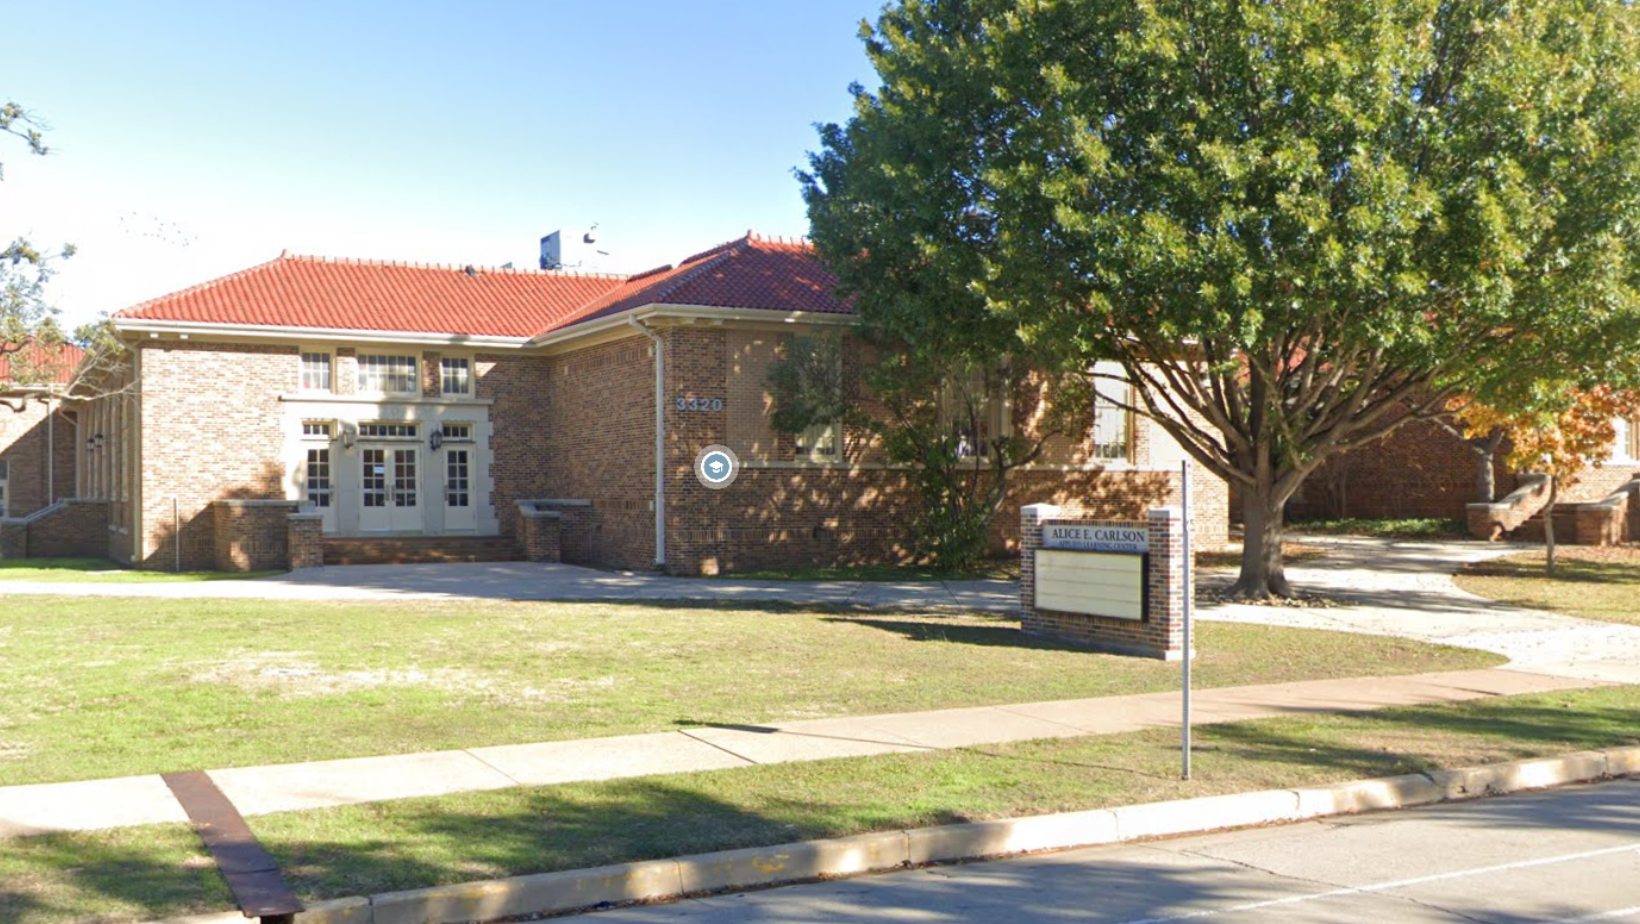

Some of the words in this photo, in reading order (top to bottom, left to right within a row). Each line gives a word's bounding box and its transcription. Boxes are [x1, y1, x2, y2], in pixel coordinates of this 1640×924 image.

[676, 397, 722, 412] 3320
[1052, 528, 1082, 540] ALICE
[1083, 529, 1092, 540] E.
[1094, 529, 1145, 543] CARLSON
[1059, 540, 1082, 548] APPLIED
[1083, 541, 1112, 549] LEARNING
[1113, 542, 1137, 550] CENTER
